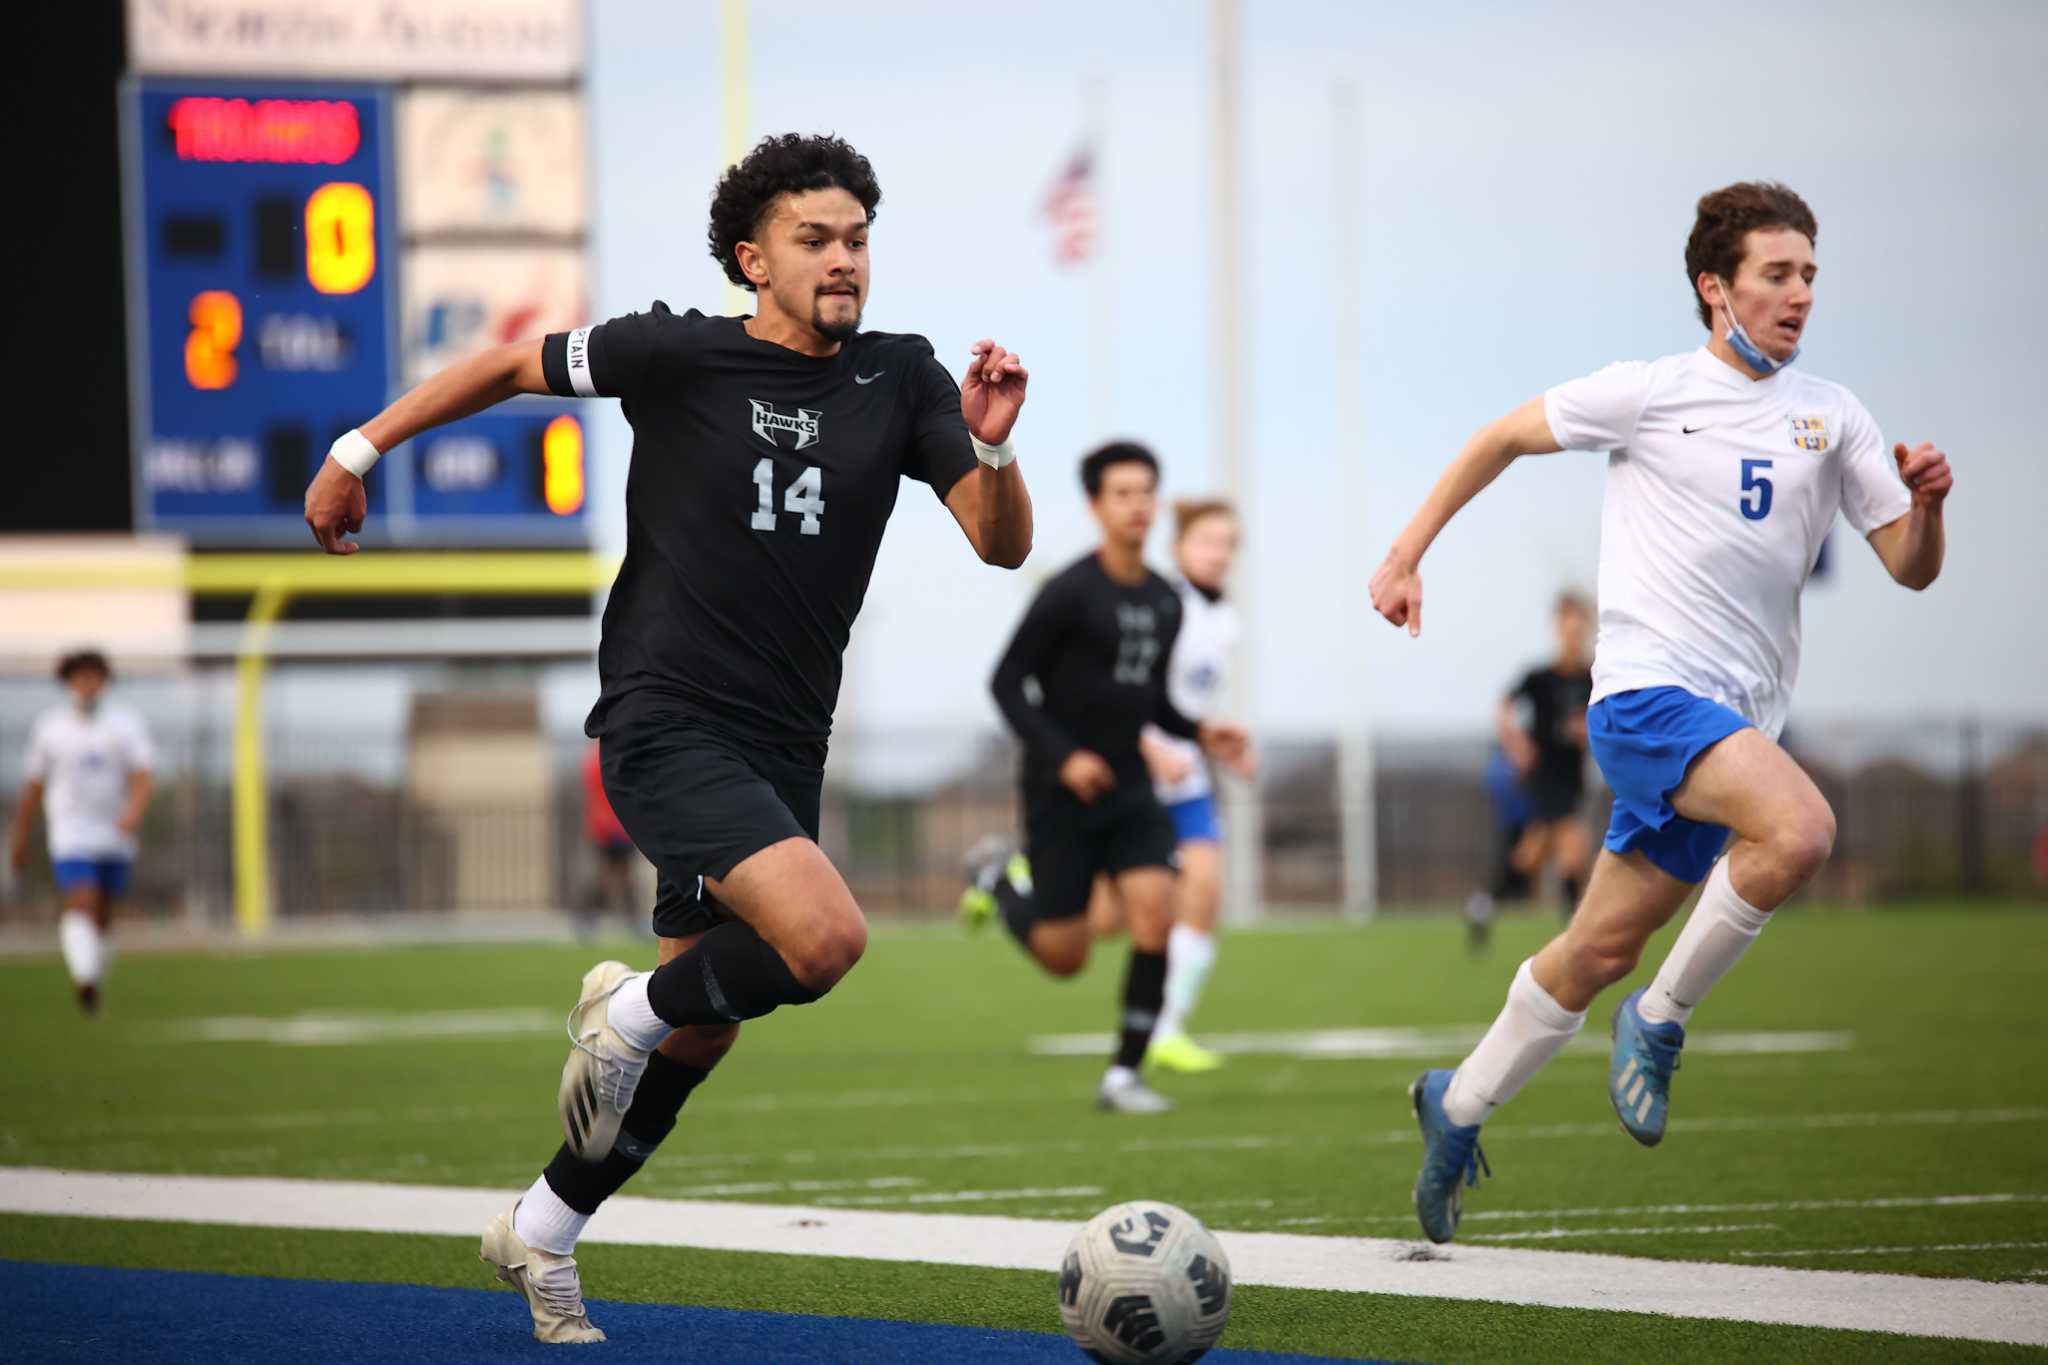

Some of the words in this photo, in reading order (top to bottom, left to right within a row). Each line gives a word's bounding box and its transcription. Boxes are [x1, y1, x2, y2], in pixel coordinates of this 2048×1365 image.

[755, 411, 816, 434] HAWKS
[751, 458, 825, 536] 14
[1740, 459, 1773, 520] 5
